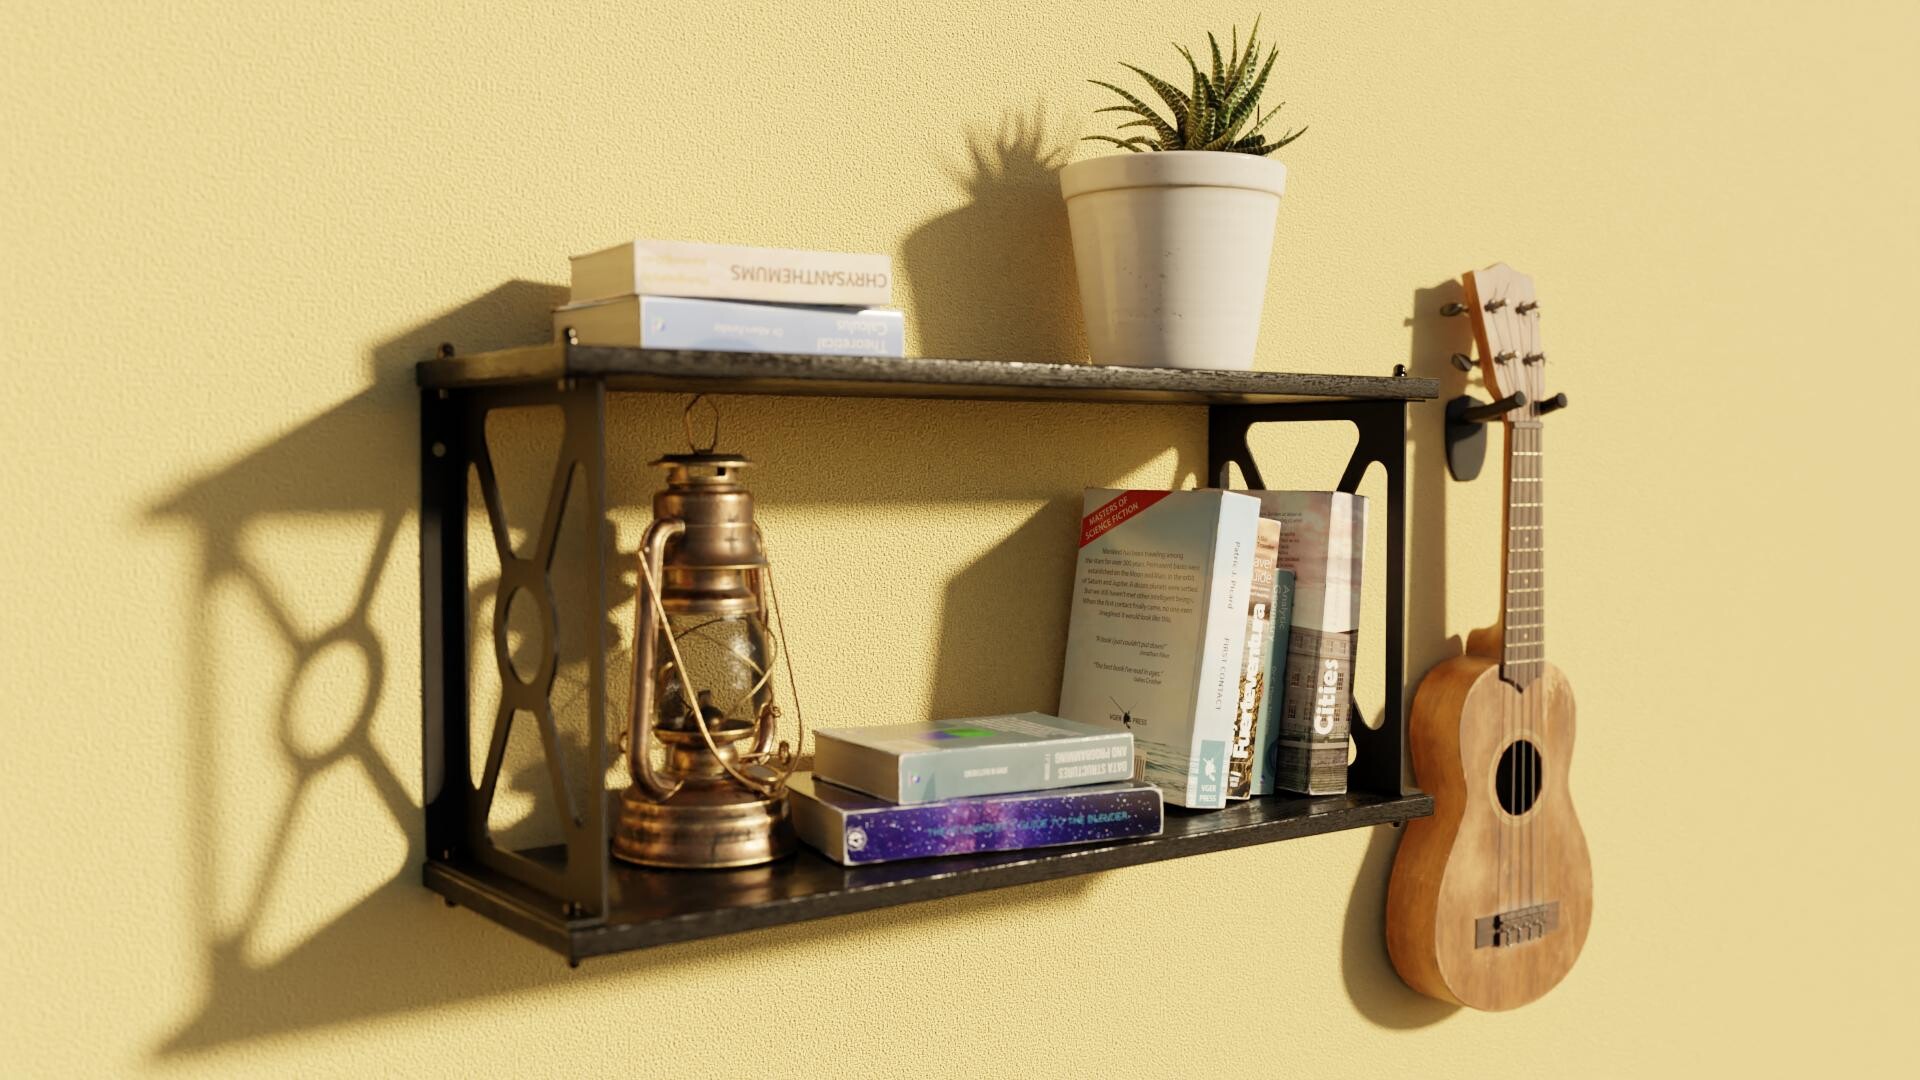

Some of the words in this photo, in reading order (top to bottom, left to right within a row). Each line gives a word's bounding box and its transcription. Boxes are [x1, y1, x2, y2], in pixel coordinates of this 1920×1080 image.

[730, 264, 888, 289] CHRYSANTHEMUMS
[836, 319, 888, 336] Calculus
[816, 336, 888, 354] Theoretical
[1085, 519, 1112, 540] SCIENCE
[1111, 502, 1139, 523] FICTION
[1089, 502, 1118, 526] MASTERS
[1118, 495, 1128, 508] OF
[1253, 558, 1273, 570] avel
[1227, 580, 1237, 610] Picard
[1279, 585, 1291, 631] Analytic
[1220, 637, 1230, 662] FIRST
[1215, 665, 1226, 711] CONTACT
[1232, 603, 1266, 758] Fuerteventura
[1313, 659, 1339, 735] Cities
[1132, 717, 1147, 725] PRESS
[1054, 748, 1111, 764] PROGRAMMING
[1112, 745, 1128, 758] AND
[1057, 762, 1106, 780] STRUCTURES
[1107, 760, 1128, 774] DATA
